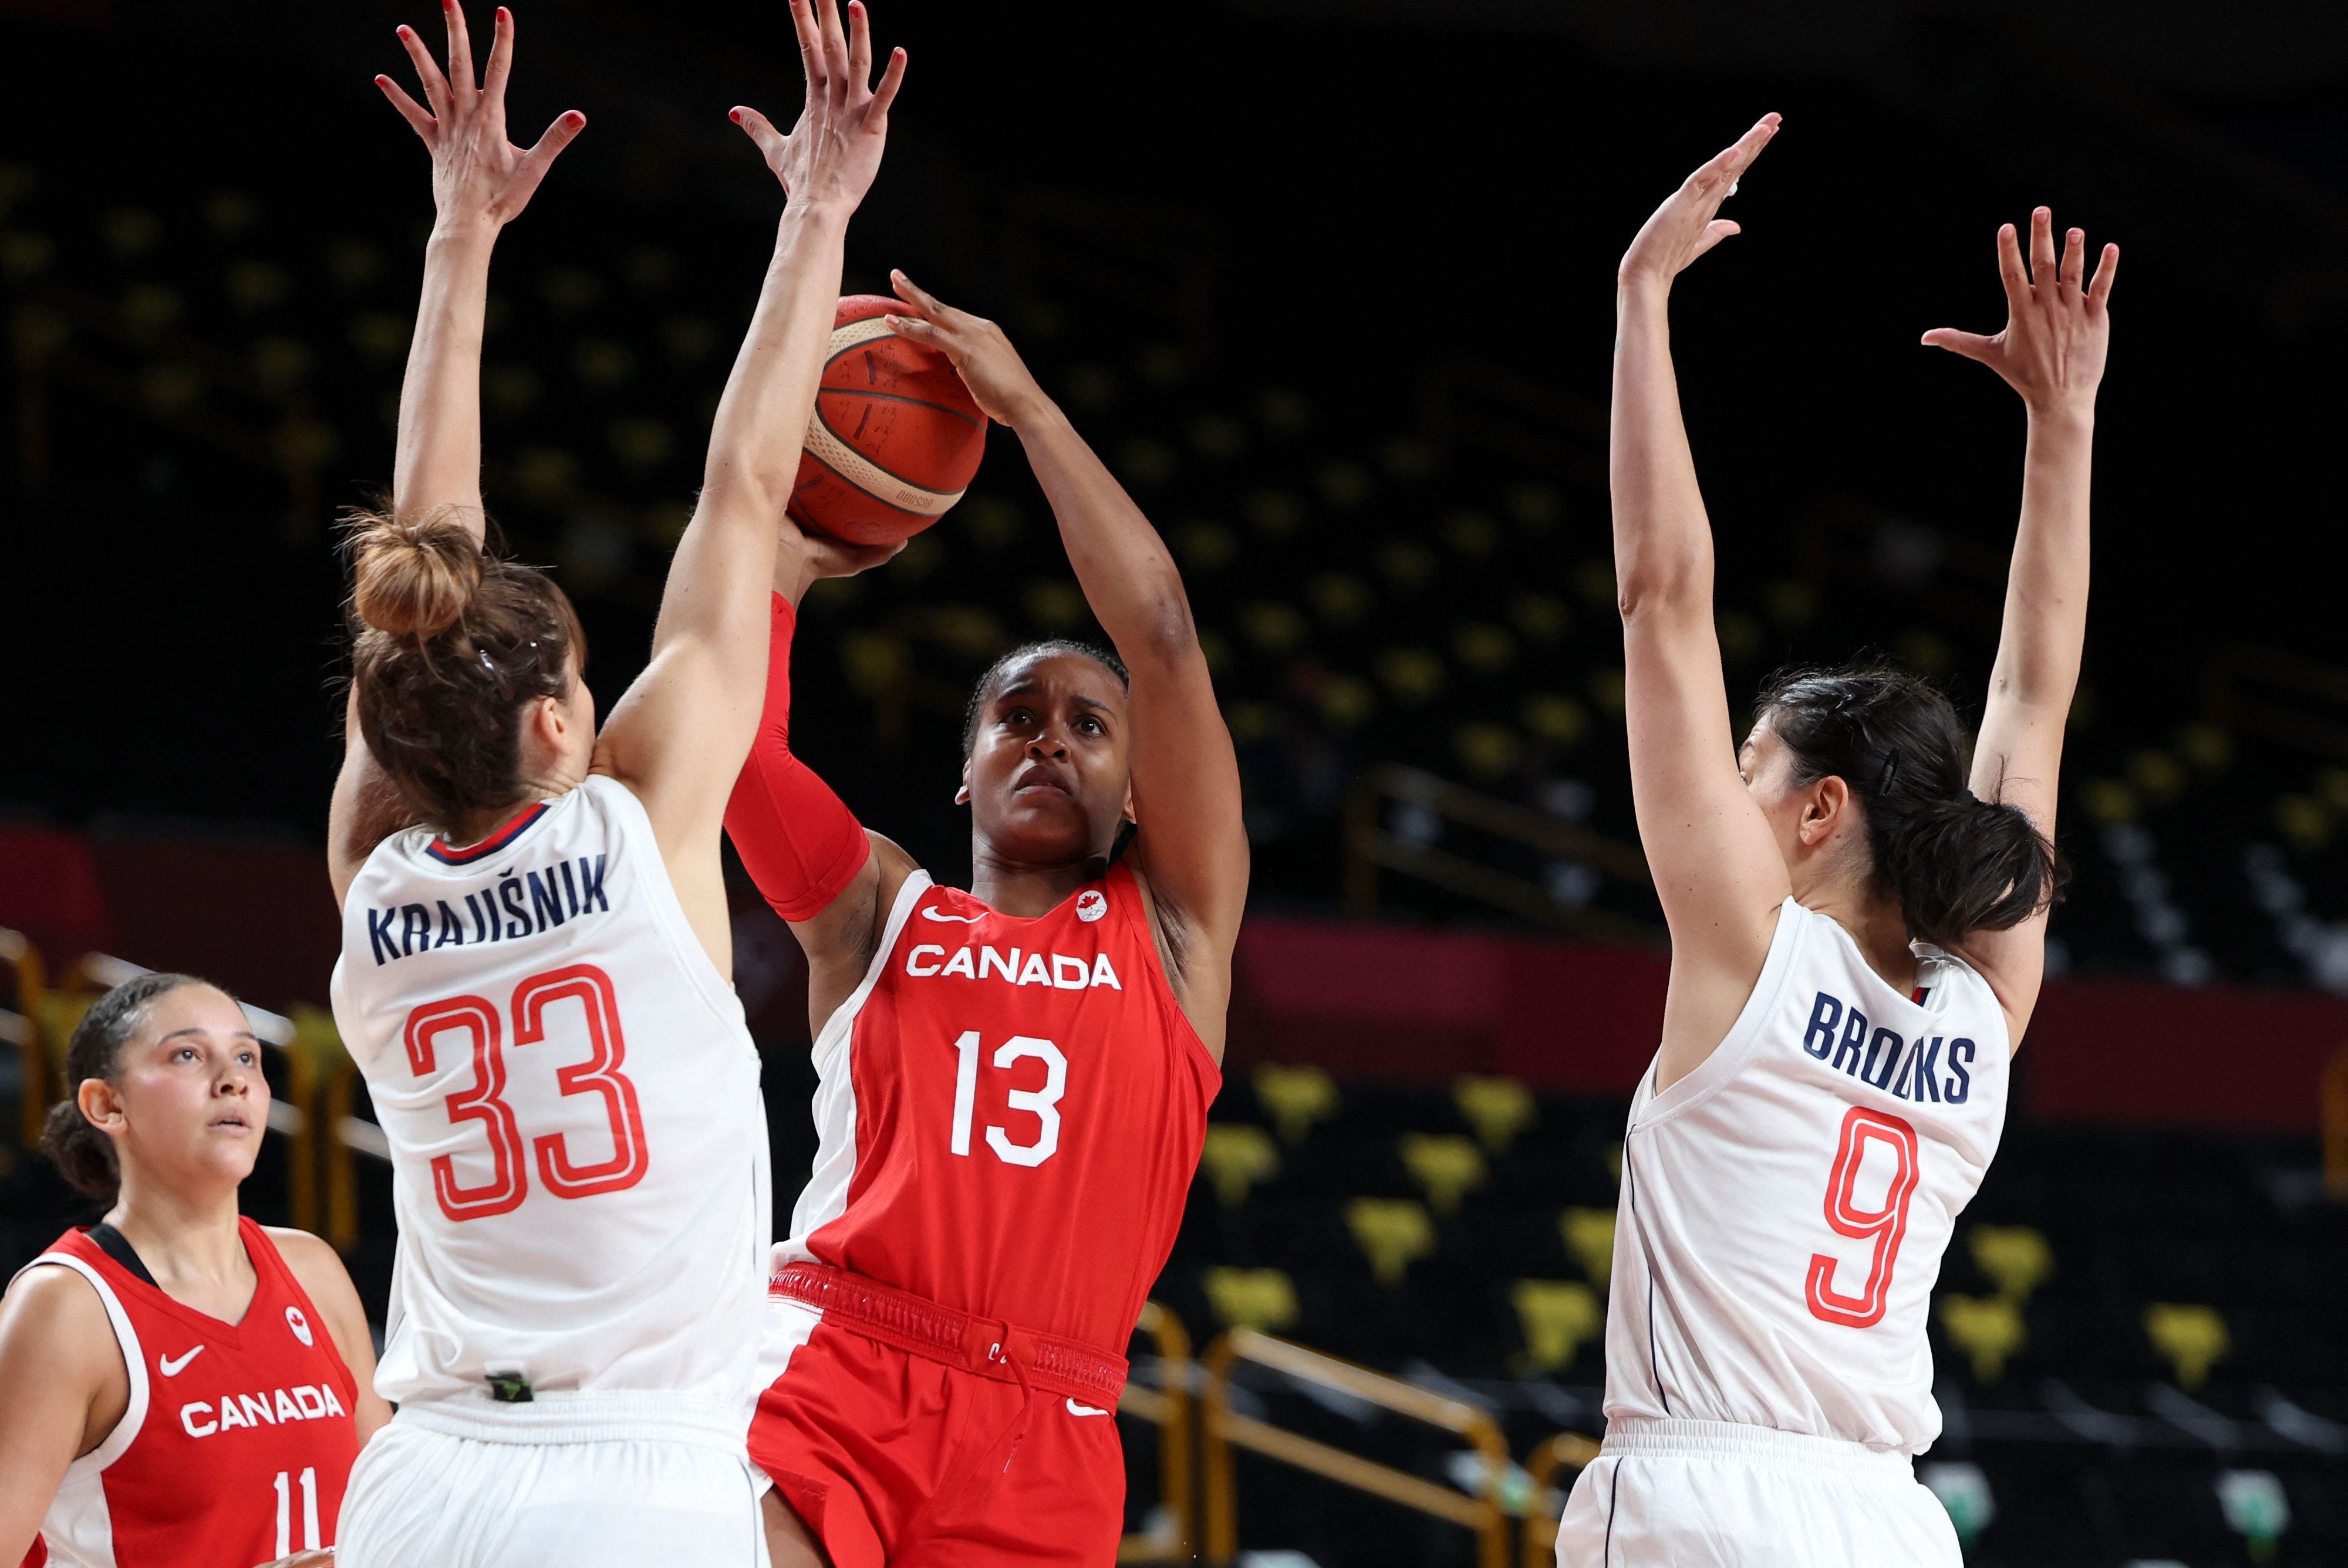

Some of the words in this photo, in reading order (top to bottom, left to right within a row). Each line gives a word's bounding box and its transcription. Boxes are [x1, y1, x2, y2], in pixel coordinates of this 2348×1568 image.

[905, 944, 1122, 991] CANADA
[404, 964, 649, 1222] 33
[950, 1030, 1068, 1167] 13
[1805, 1106, 1919, 1329] 9
[180, 1384, 345, 1438] CANADA
[274, 1466, 321, 1561] 11
